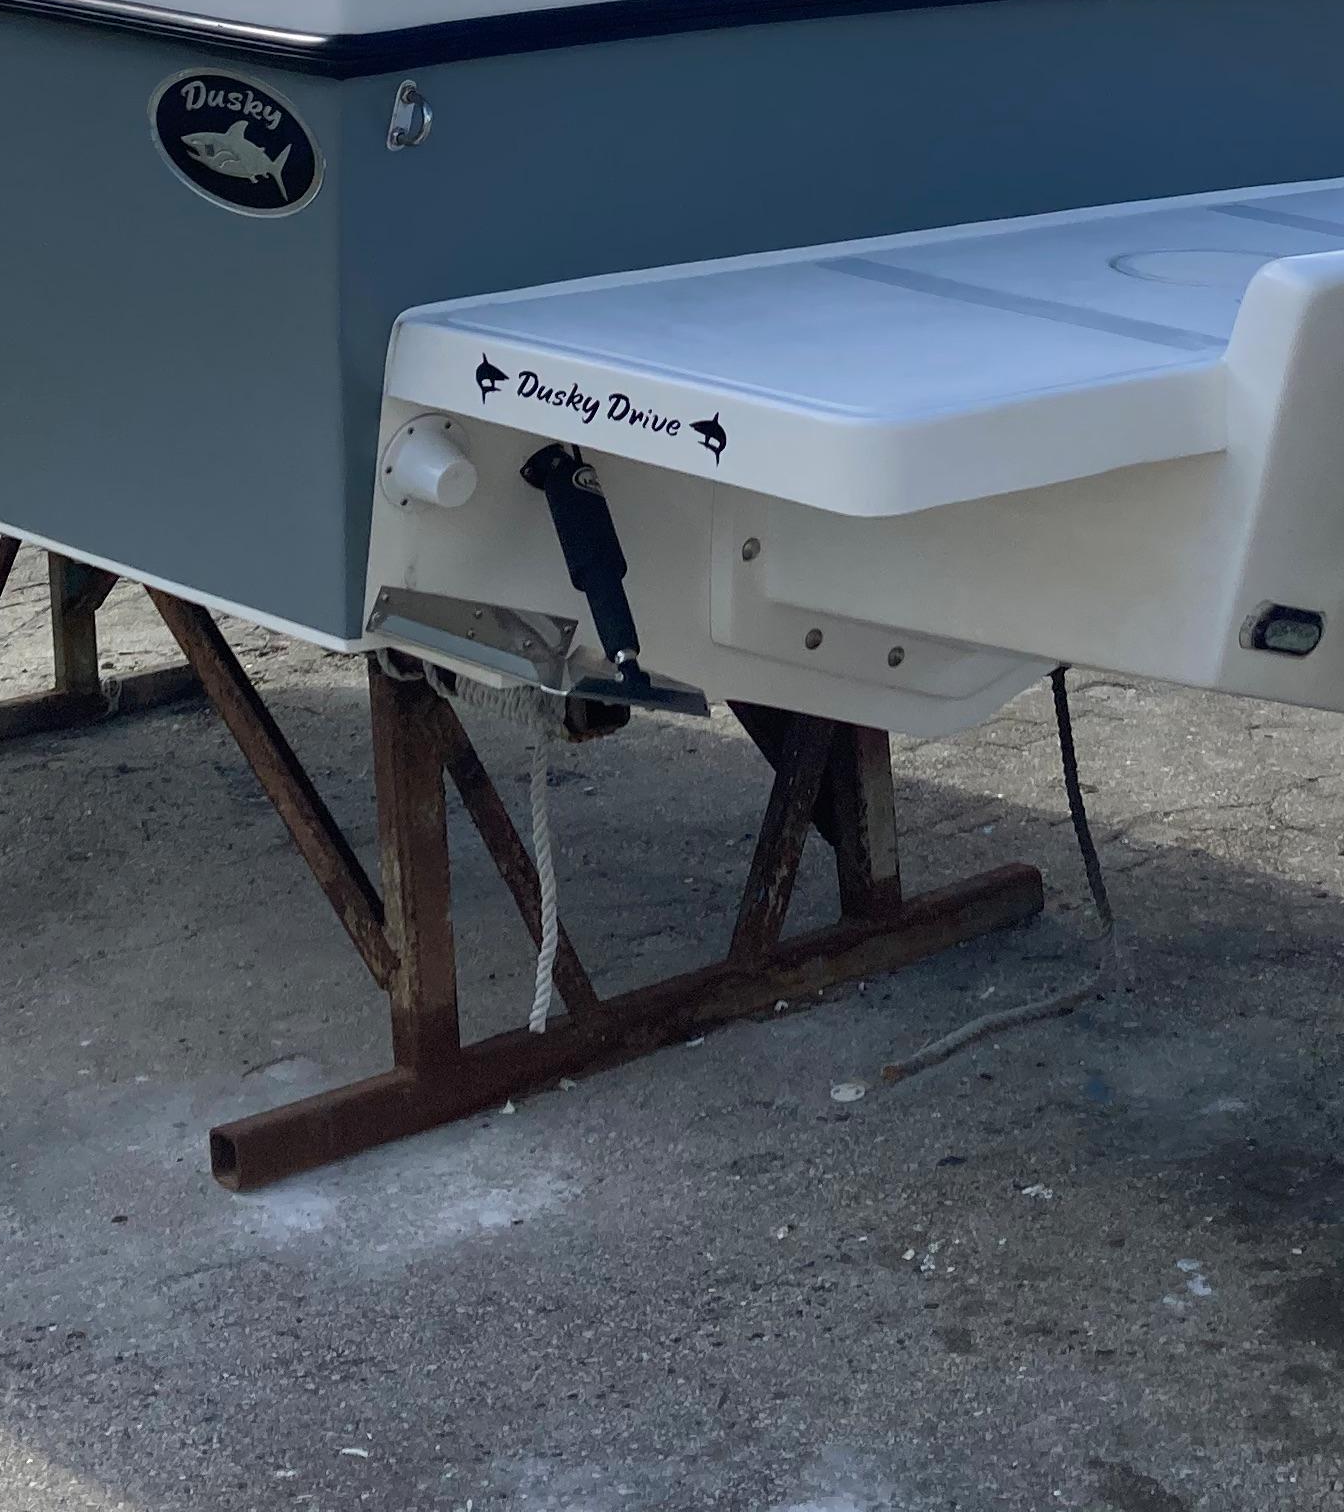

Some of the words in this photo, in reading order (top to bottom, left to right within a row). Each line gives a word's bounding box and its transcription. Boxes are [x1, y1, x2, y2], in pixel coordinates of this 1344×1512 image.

[180, 80, 282, 130] Dusky
[516, 370, 600, 424] Dusky
[605, 393, 682, 437] Drive
